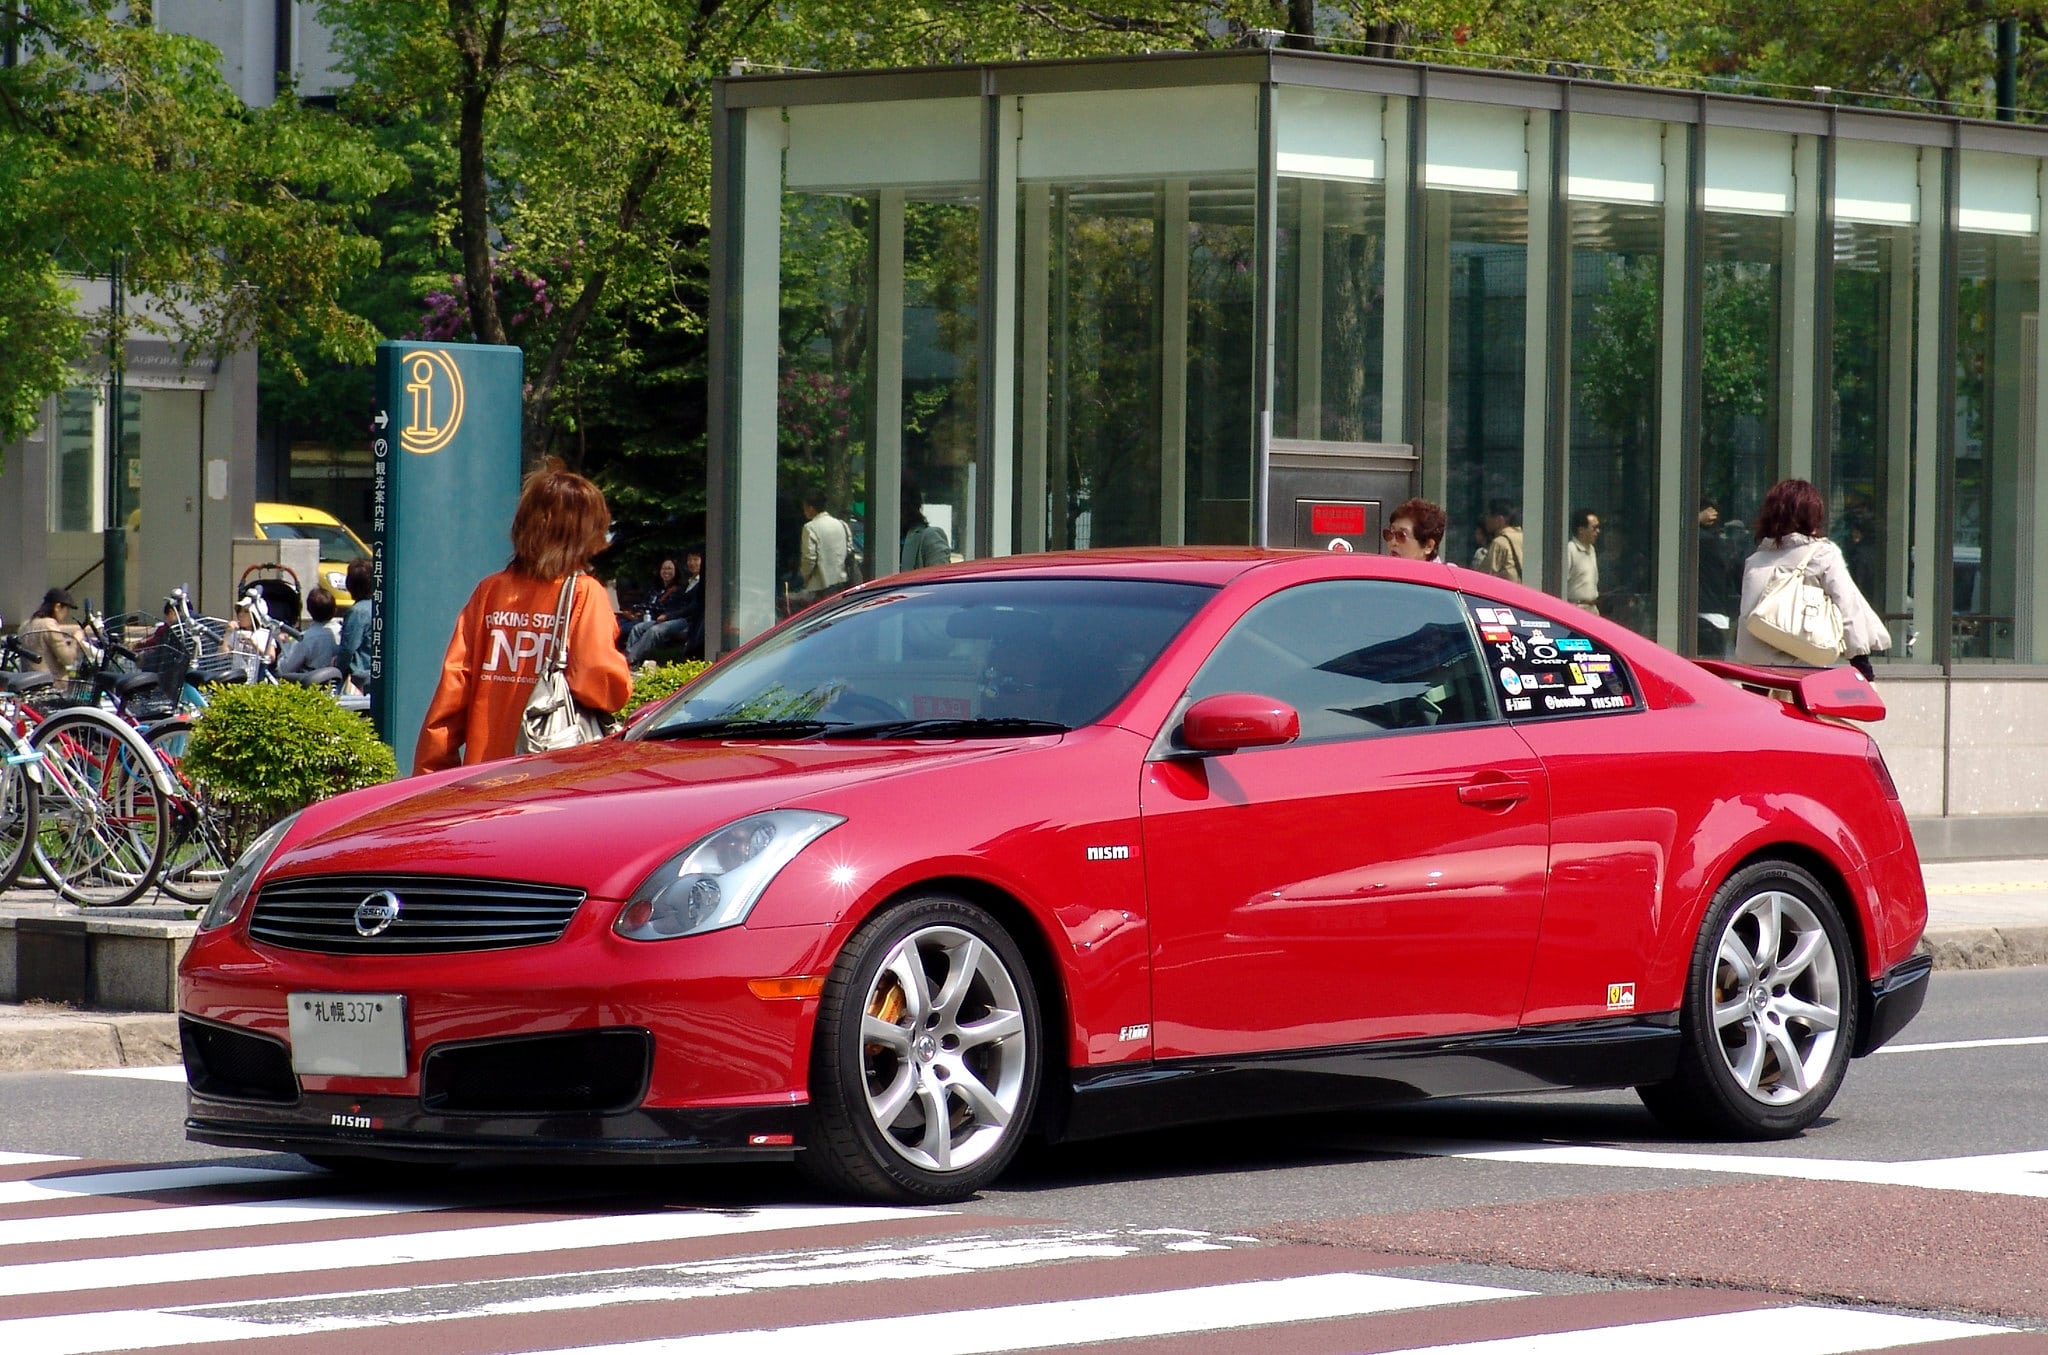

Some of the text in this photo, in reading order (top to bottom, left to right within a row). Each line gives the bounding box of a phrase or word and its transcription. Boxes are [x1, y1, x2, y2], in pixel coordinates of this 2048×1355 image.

[1591, 694, 1633, 710] nismo
[1087, 844, 1140, 861] nismo
[357, 908, 389, 917] SSAN
